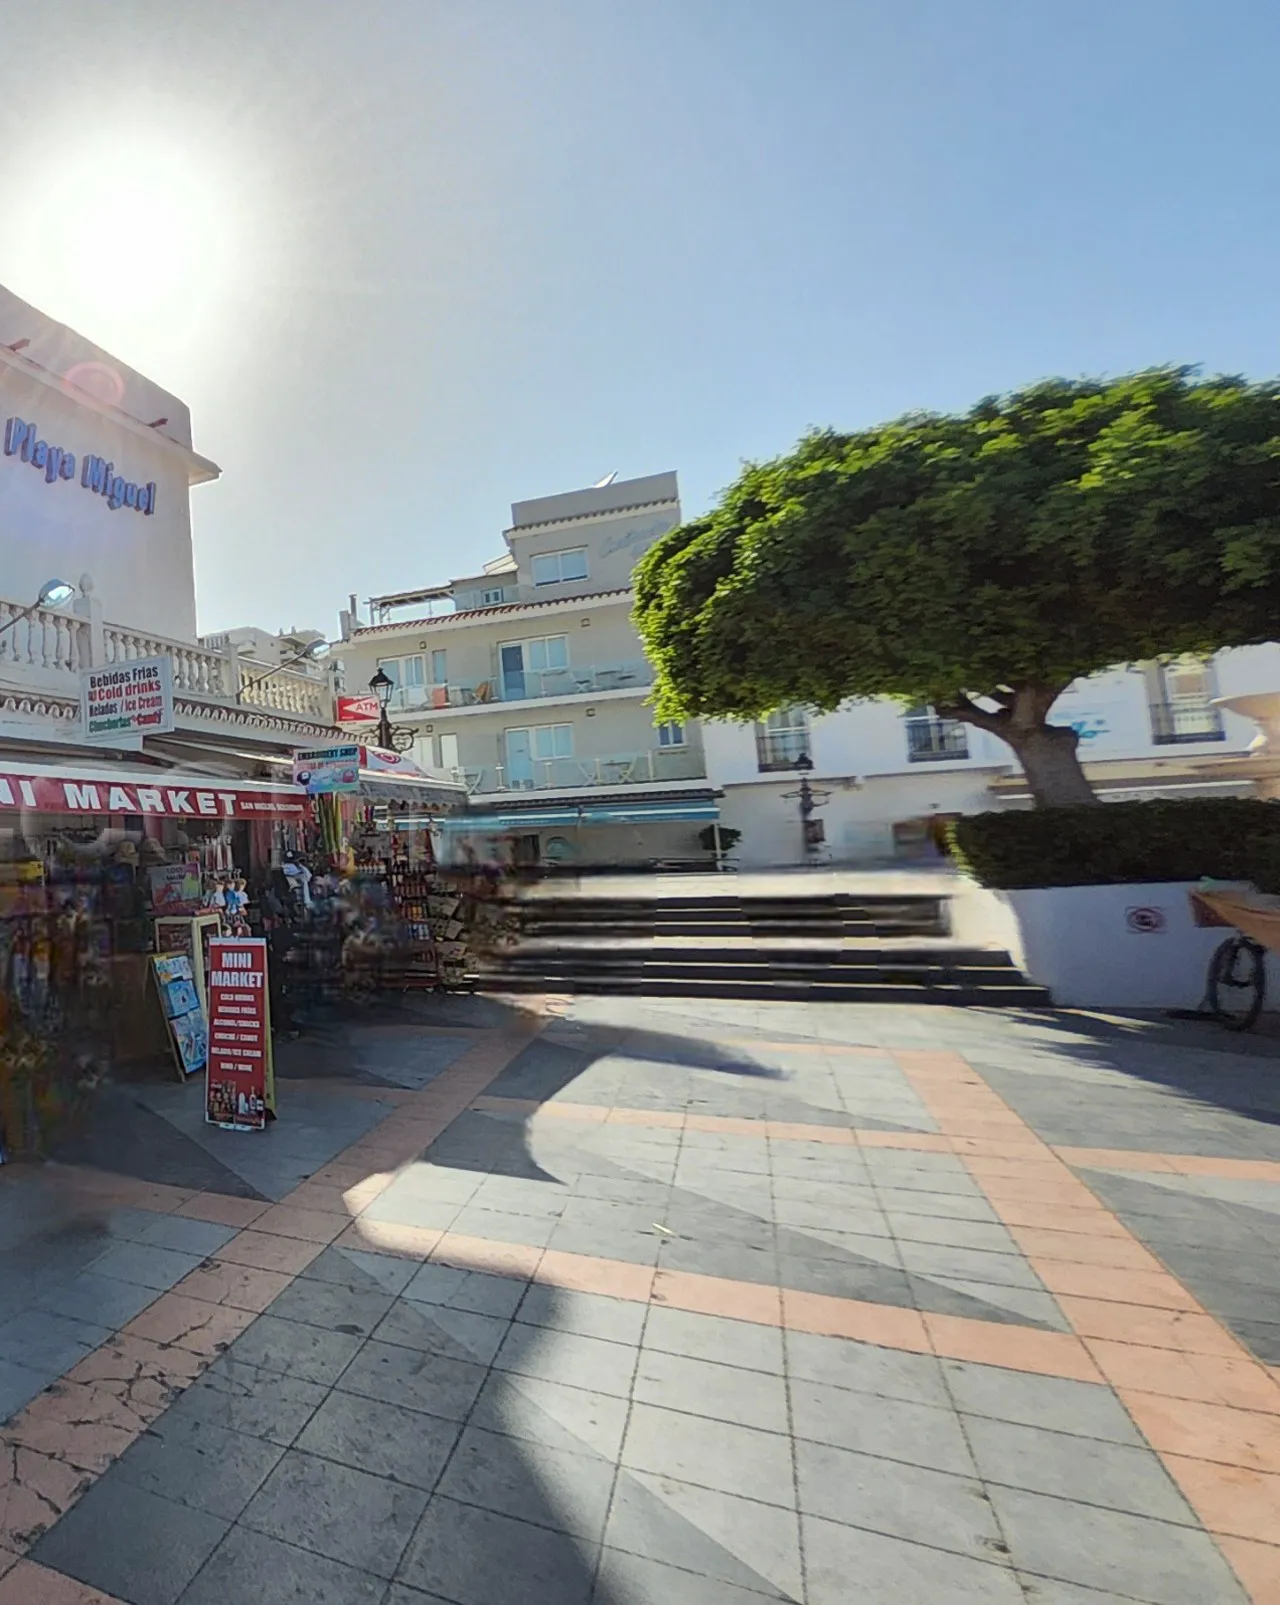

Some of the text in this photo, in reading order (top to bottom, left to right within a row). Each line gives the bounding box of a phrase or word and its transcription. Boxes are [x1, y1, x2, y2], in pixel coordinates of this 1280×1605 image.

[3, 416, 157, 516] Playa Miguel
[90, 671, 131, 689] Bebidas
[98, 679, 161, 701] Cold drinks
[125, 700, 136, 712] Ice
[138, 696, 162, 709] Cream
[356, 702, 379, 711] ATM
[63, 783, 237, 815] MARKET
[221, 952, 252, 968] MINI
[211, 971, 263, 988] MARKET
